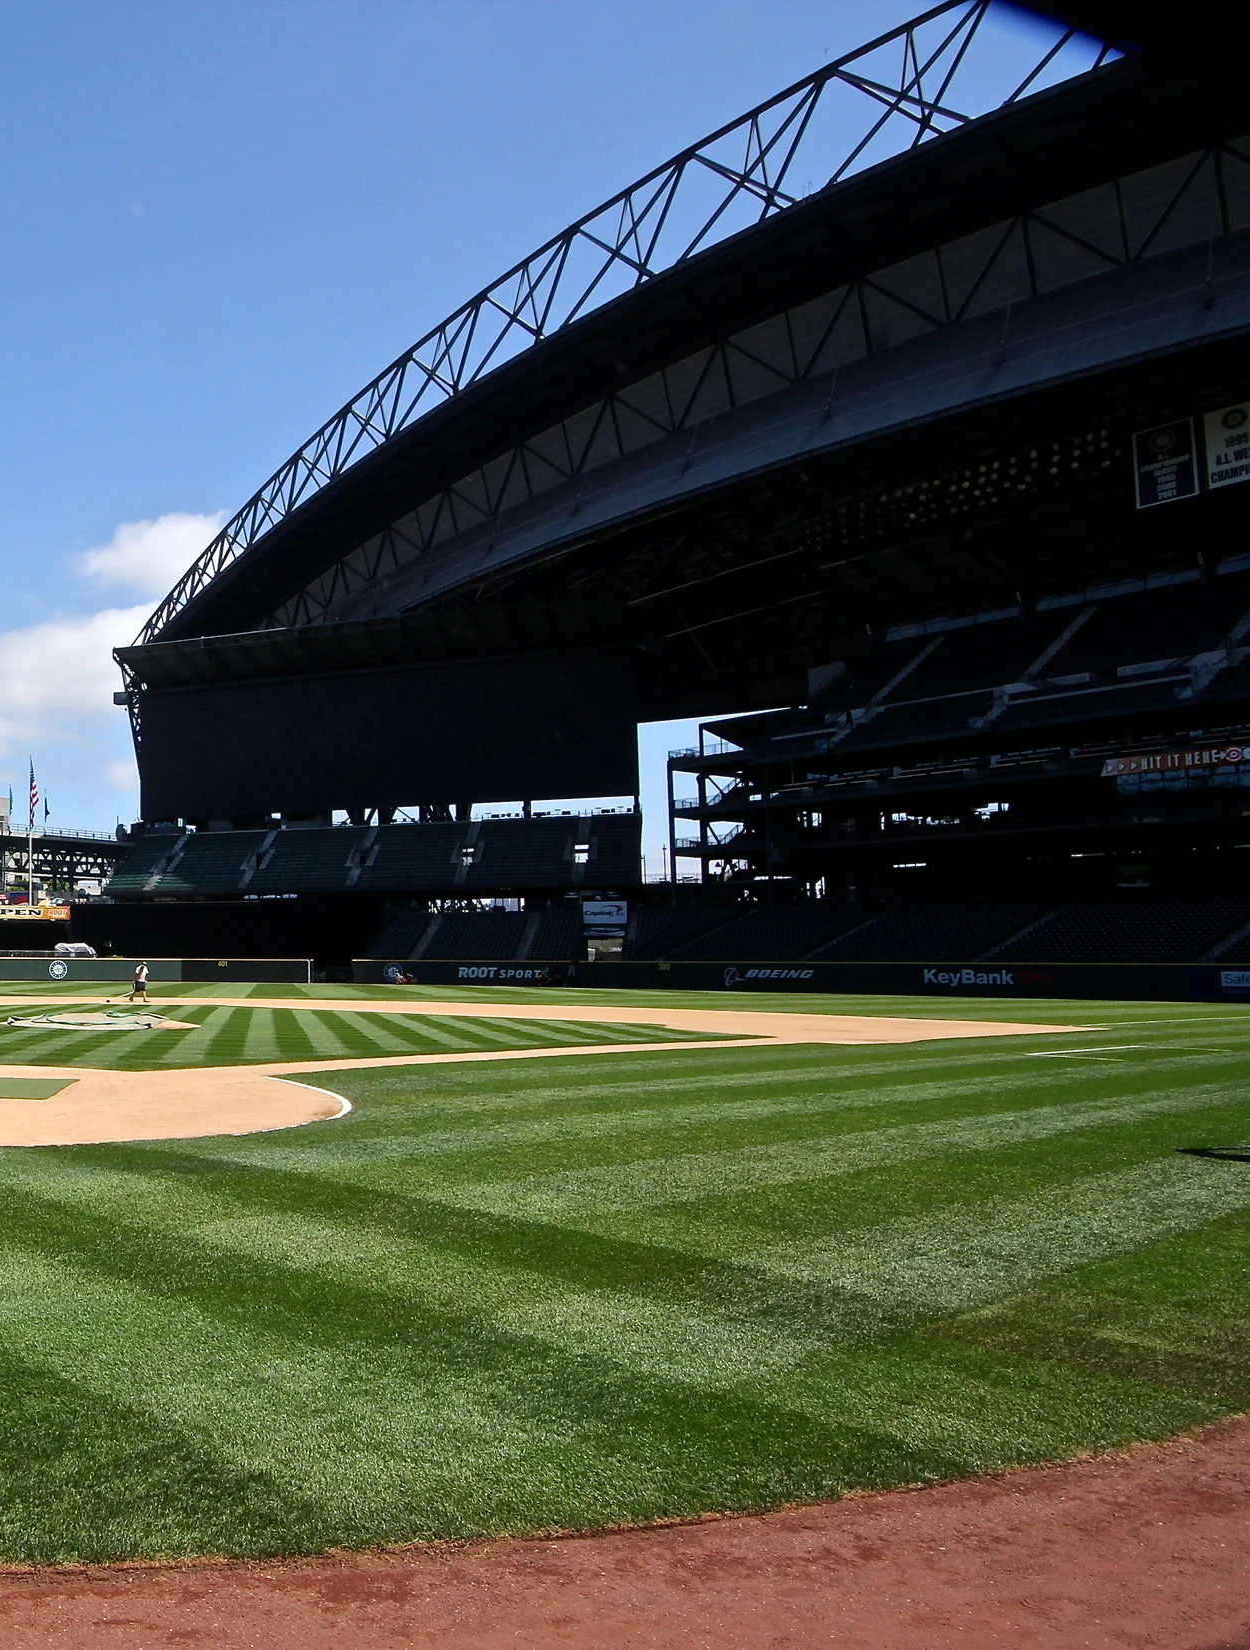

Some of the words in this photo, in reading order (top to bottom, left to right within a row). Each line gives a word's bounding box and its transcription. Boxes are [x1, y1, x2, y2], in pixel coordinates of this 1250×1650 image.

[1141, 756, 1162, 770] HIT
[1167, 754, 1180, 768] IT
[1185, 750, 1218, 766] HERE
[458, 967, 498, 978] ROOT
[745, 969, 814, 979] BOEING
[923, 968, 1015, 987] KeyBank
